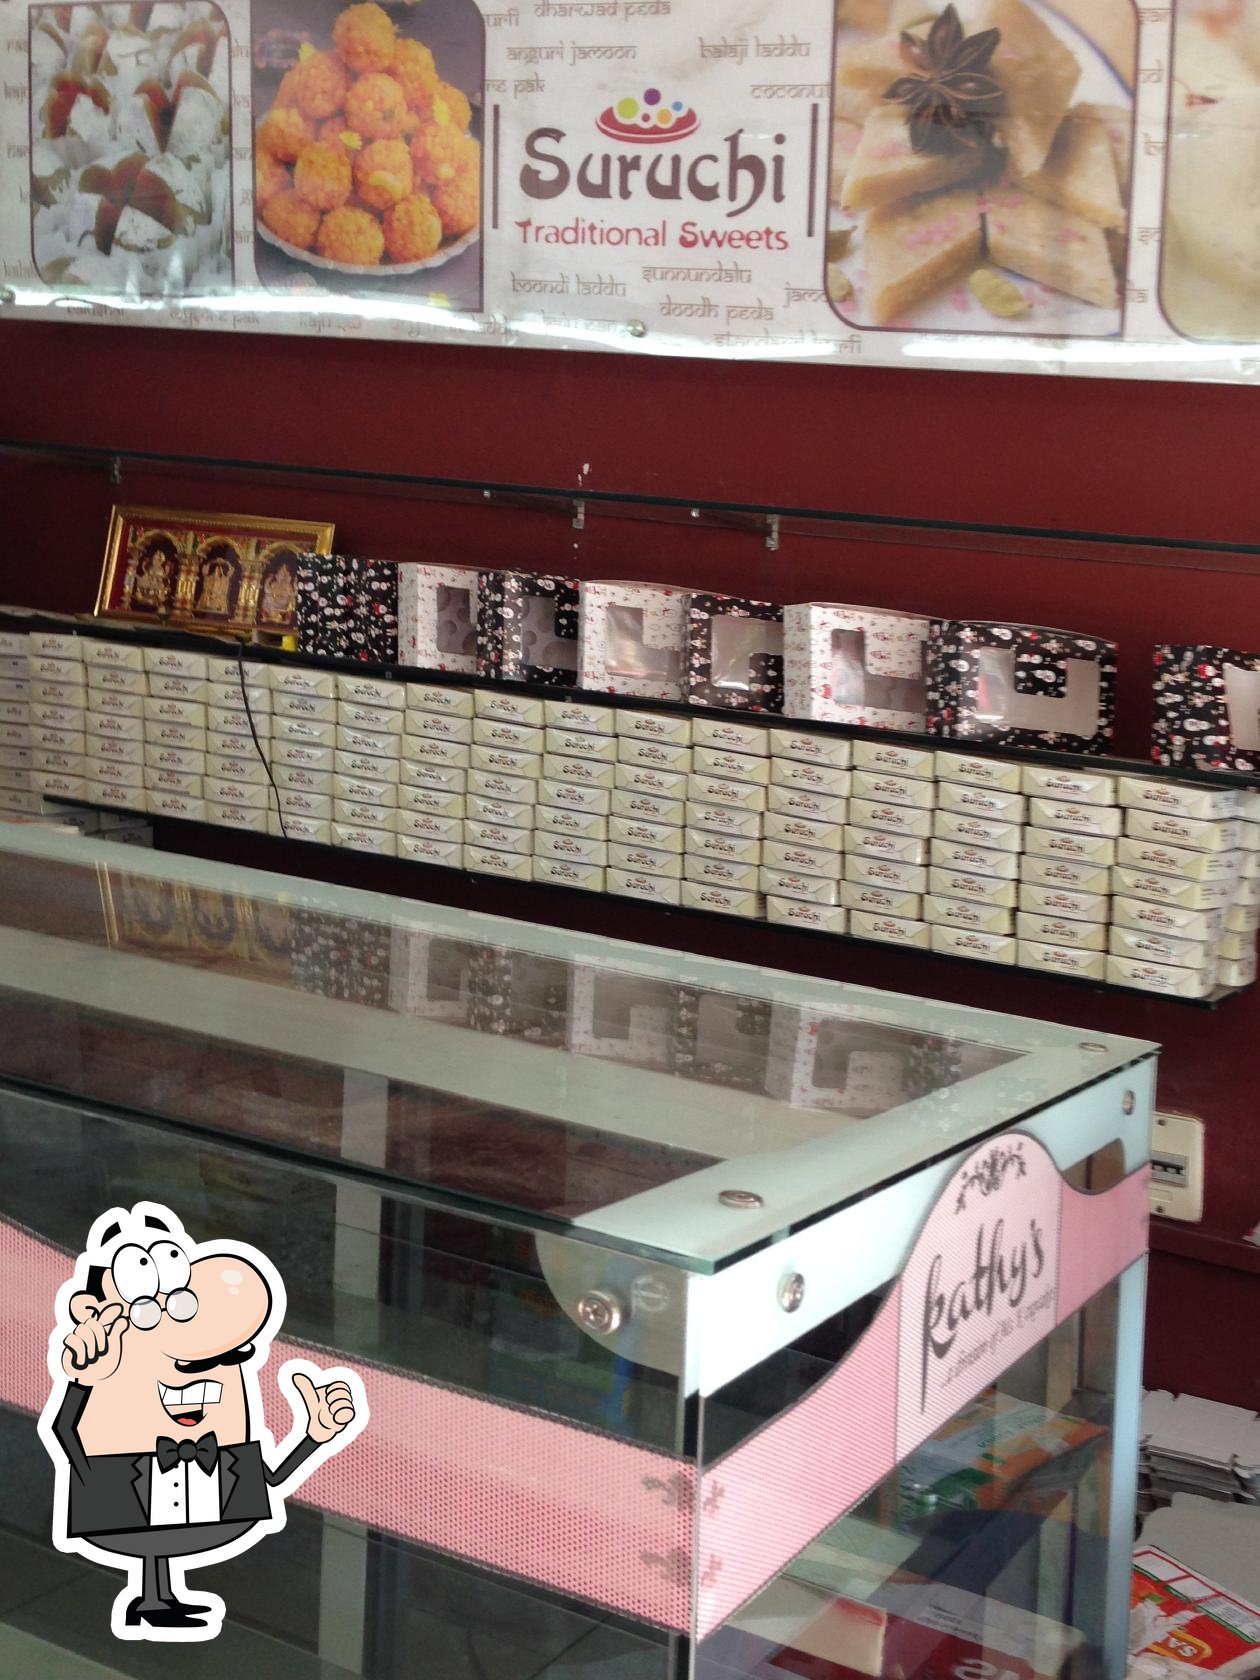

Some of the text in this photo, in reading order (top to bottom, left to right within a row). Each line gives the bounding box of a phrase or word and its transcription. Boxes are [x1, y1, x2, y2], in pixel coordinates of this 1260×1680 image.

[506, 41, 637, 66] anguri jamoon
[699, 34, 810, 65] balaji laddu
[513, 72, 545, 99] pak
[519, 127, 786, 217] Suruchi
[515, 217, 789, 250] Traditional Sweets
[511, 272, 627, 297] boondi laddu
[641, 261, 752, 284] sunnundalu
[659, 295, 774, 326] doodh peda
